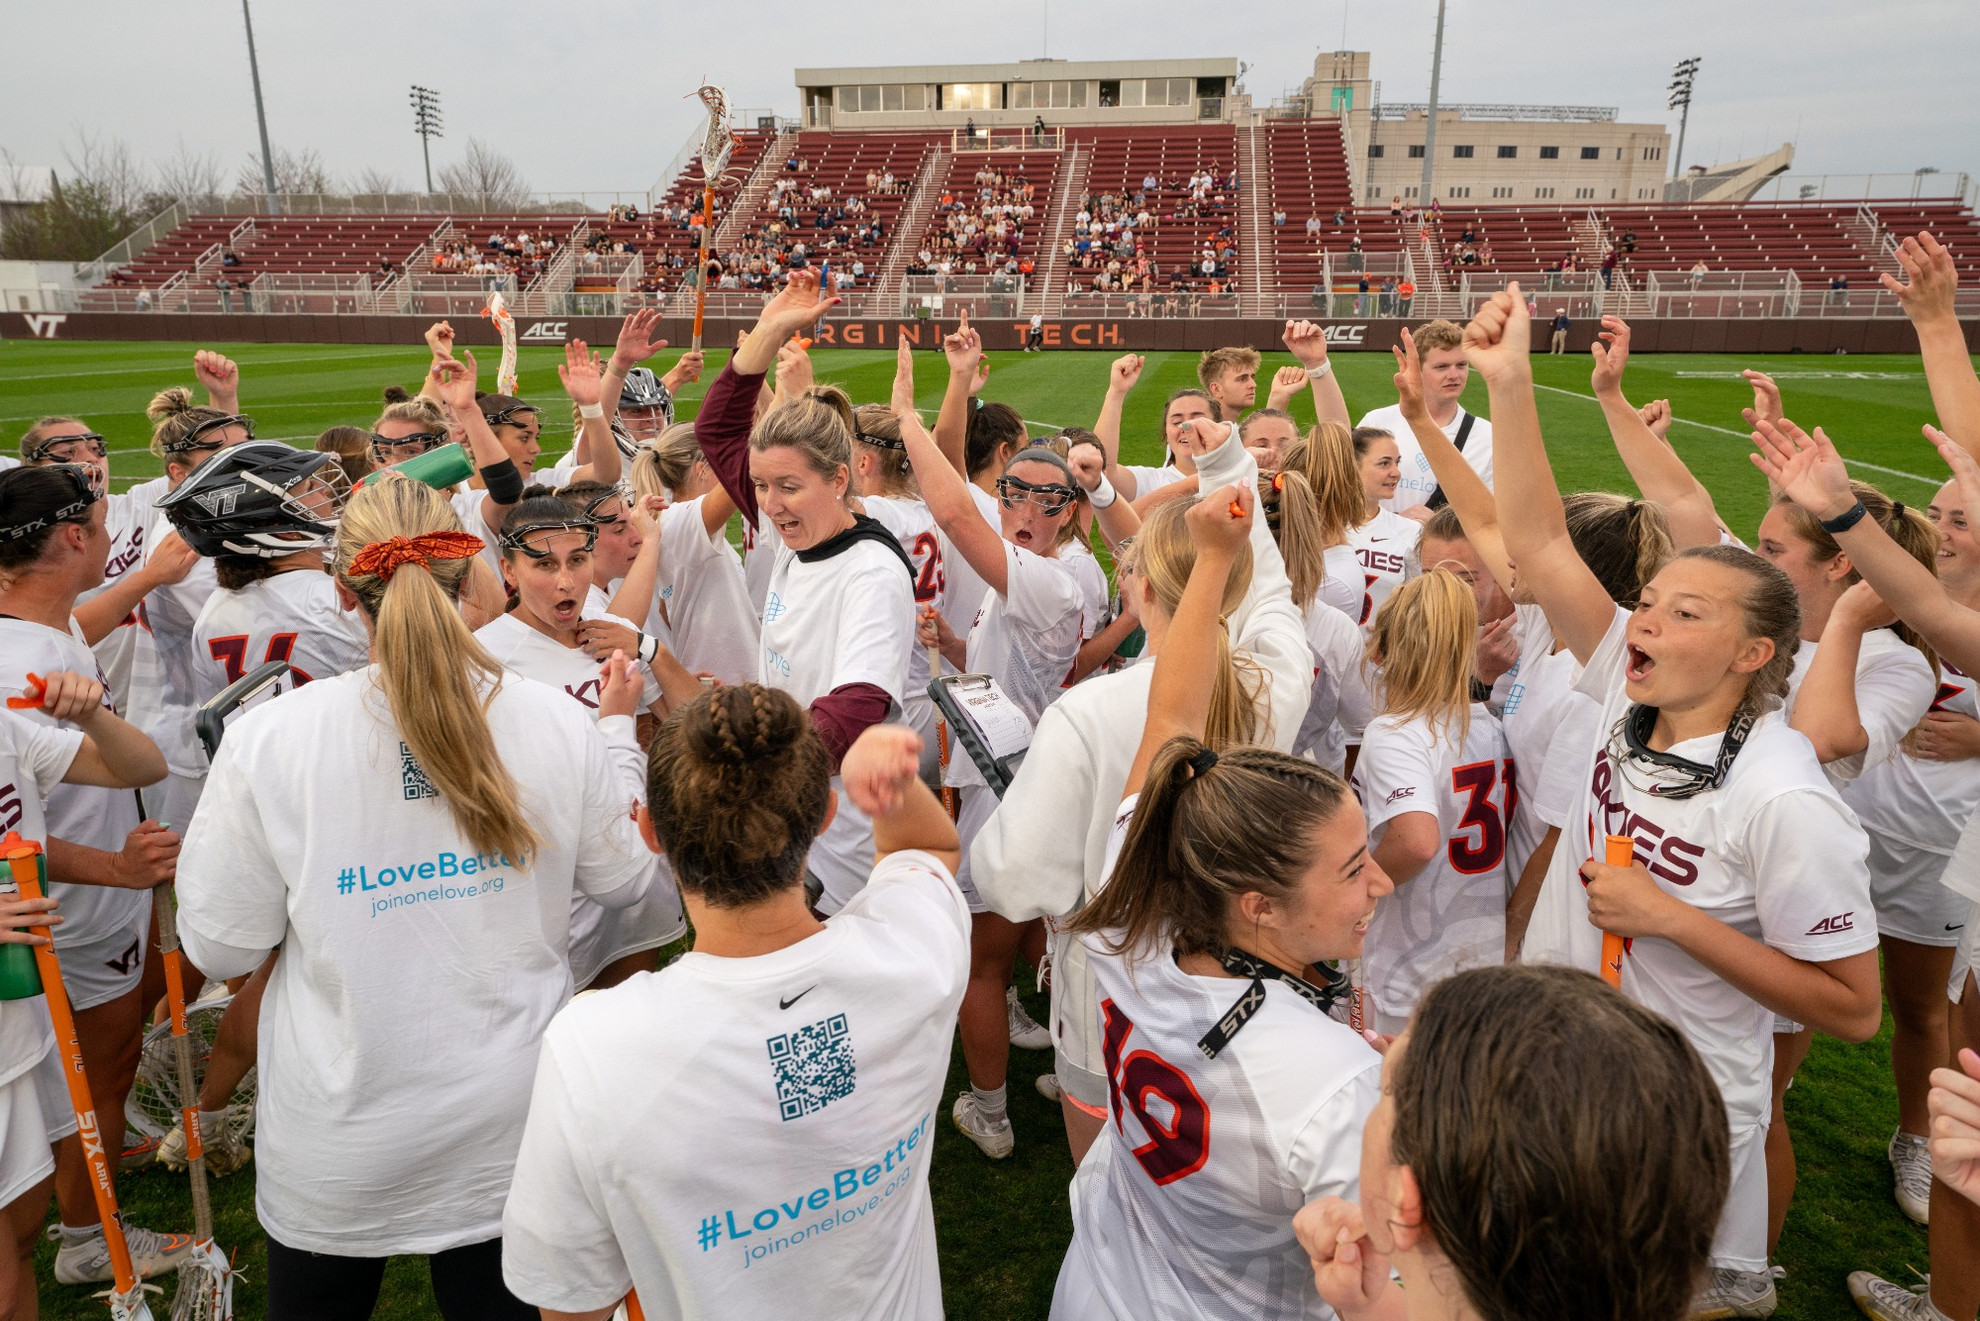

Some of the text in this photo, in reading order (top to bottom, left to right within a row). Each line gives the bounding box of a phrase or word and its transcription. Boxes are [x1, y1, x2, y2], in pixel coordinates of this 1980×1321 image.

[23, 314, 67, 338] VT
[520, 322, 568, 340] ACC
[864, 435, 888, 447] STX
[55, 499, 87, 519] STX
[192, 484, 247, 518] VT
[11, 517, 47, 539] STX
[1385, 786, 1417, 806] ACC
[371, 876, 504, 918] joinonelove.org
[1805, 912, 1855, 936] ACC
[1219, 986, 1265, 1039] STX
[189, 1110, 202, 1140] ARIA
[76, 1109, 106, 1161] STX
[94, 1161, 108, 1191] ARIA
[697, 1112, 931, 1253] #LoveBetter
[743, 1165, 911, 1269] joinonelove.org
